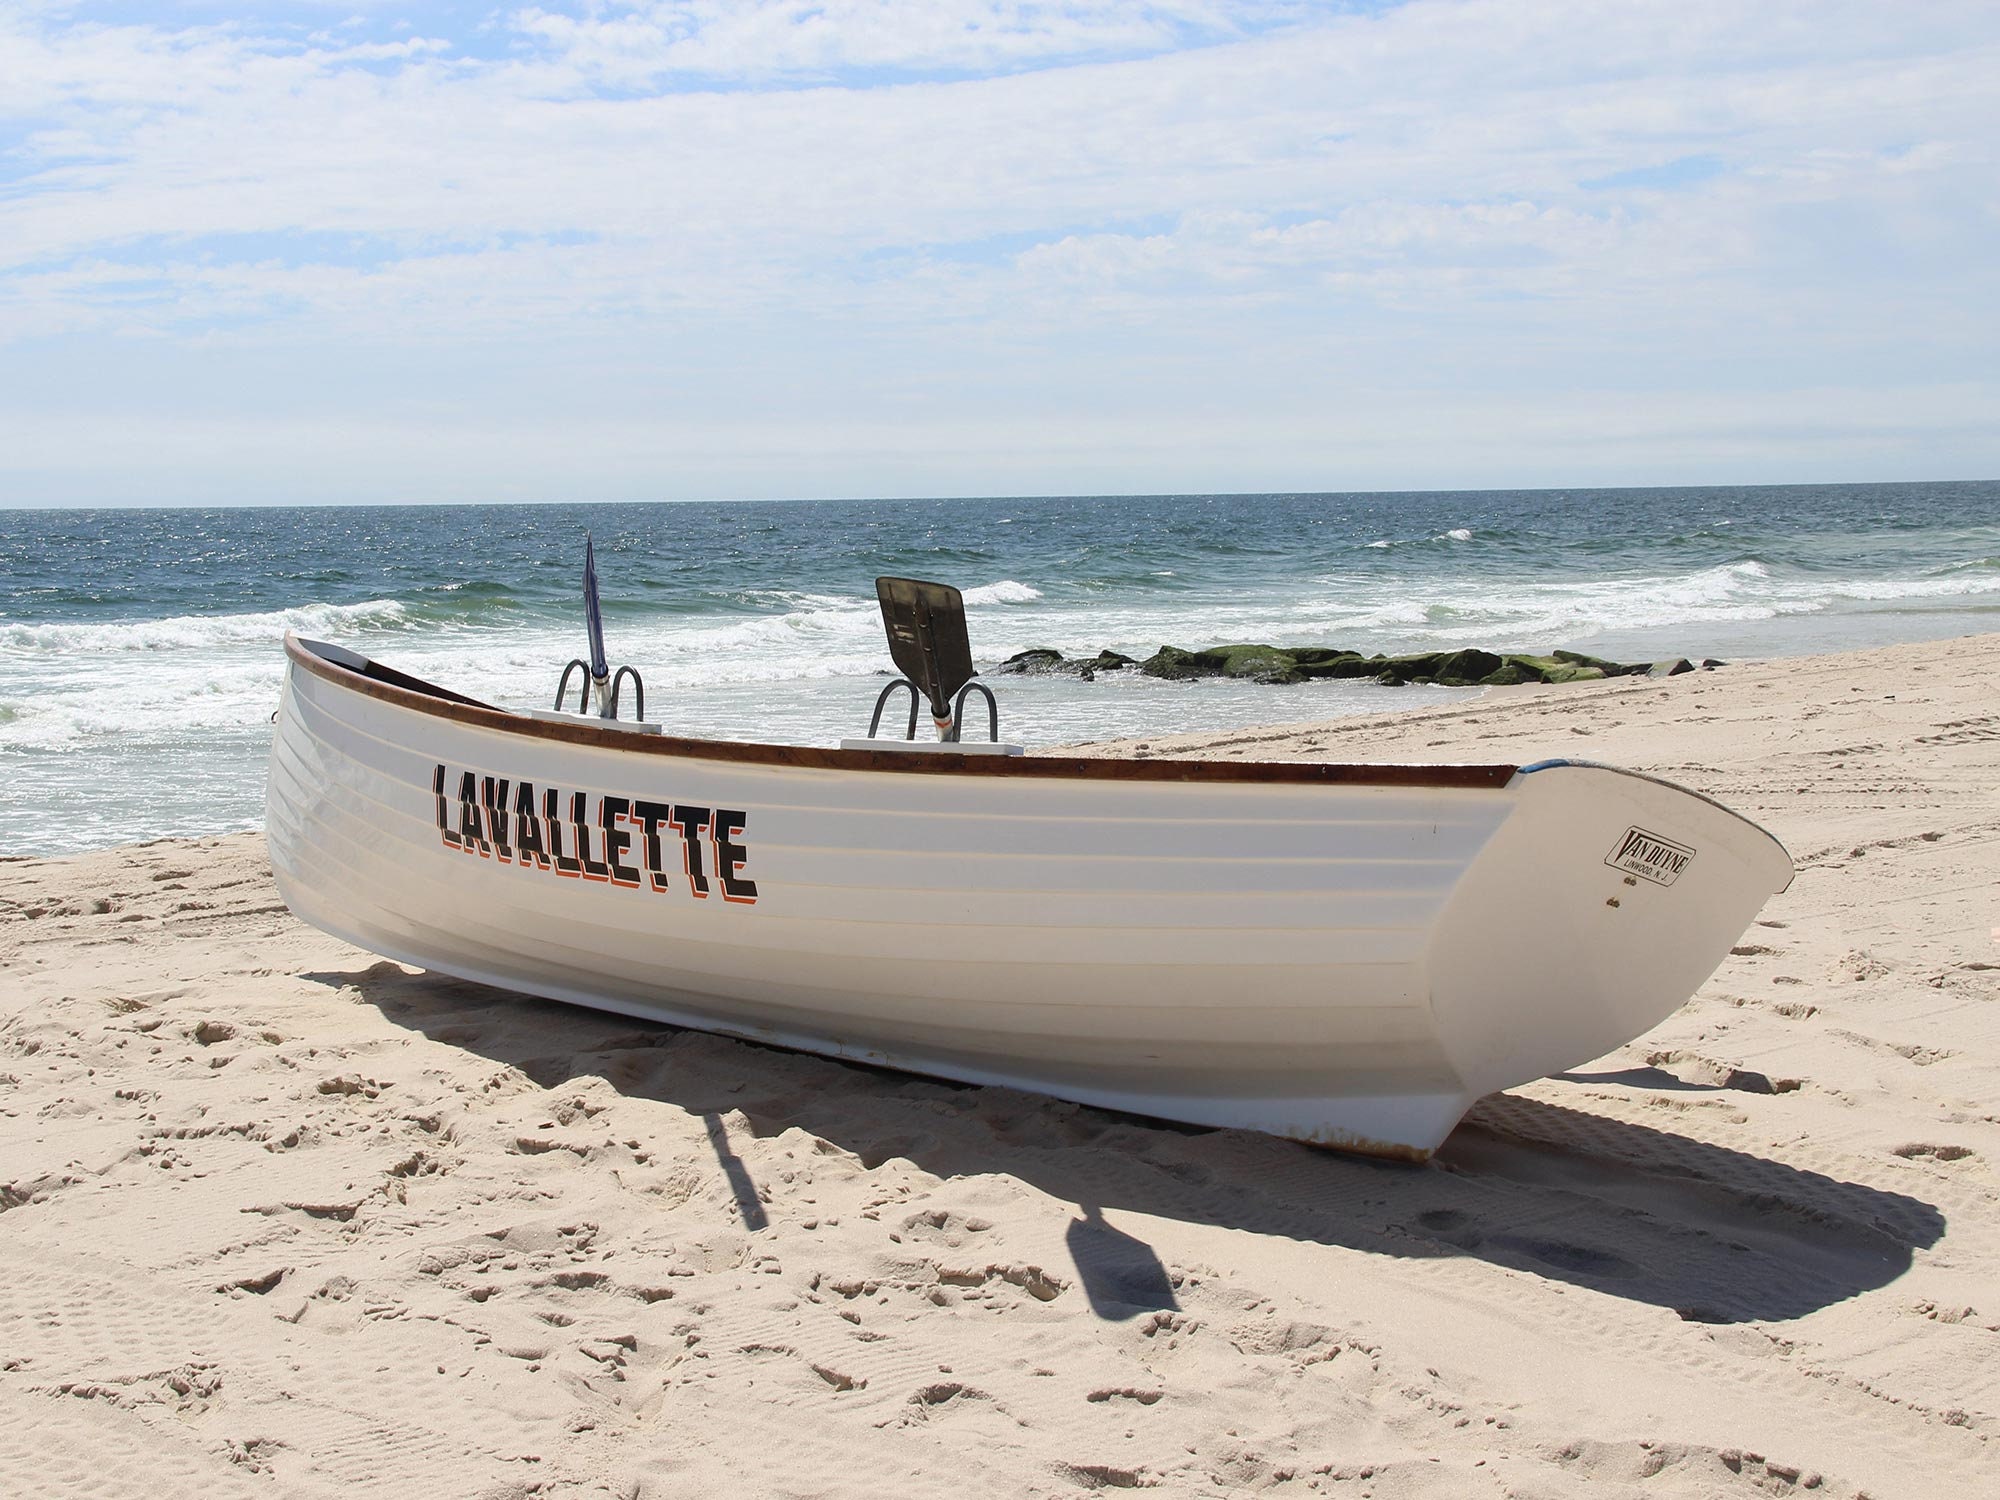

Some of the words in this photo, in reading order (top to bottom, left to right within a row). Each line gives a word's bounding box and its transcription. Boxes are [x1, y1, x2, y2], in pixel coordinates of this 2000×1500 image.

[432, 763, 758, 905] LAVALLETTE
[1614, 830, 1653, 863] VAN
[1644, 846, 1689, 873] DUYNE
